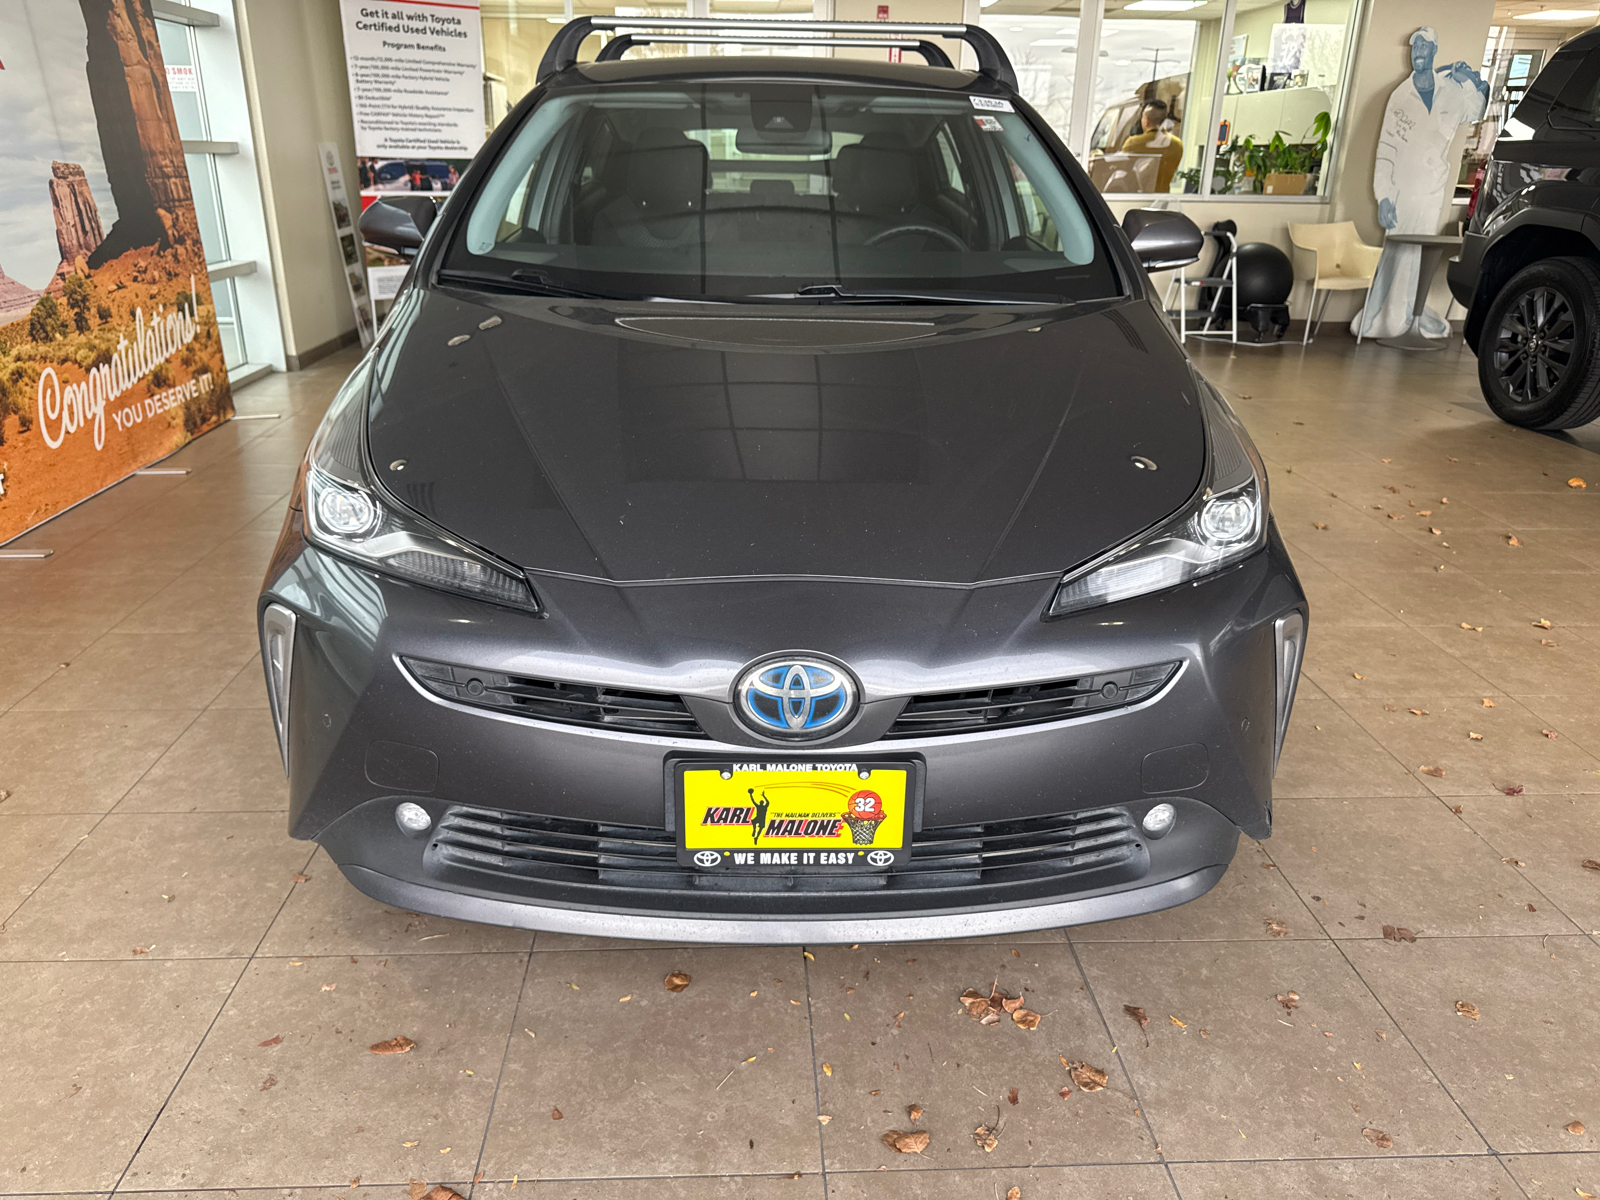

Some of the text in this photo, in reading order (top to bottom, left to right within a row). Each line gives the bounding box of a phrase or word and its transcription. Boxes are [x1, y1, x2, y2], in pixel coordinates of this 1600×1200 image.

[360, 8, 462, 26] Get it all with Toyota
[355, 21, 468, 38] Certified Used Vehicles
[382, 40, 446, 52] Program Benefits
[38, 274, 201, 451] Congratulations!
[112, 372, 214, 432] YOU DESERVE IT!
[733, 763, 858, 772] KARL MALONE TOYOTA
[854, 797, 875, 812] 32
[701, 807, 755, 825] KARL
[763, 819, 845, 837] MALONE
[733, 852, 855, 865] WE MAKE IT EASY
